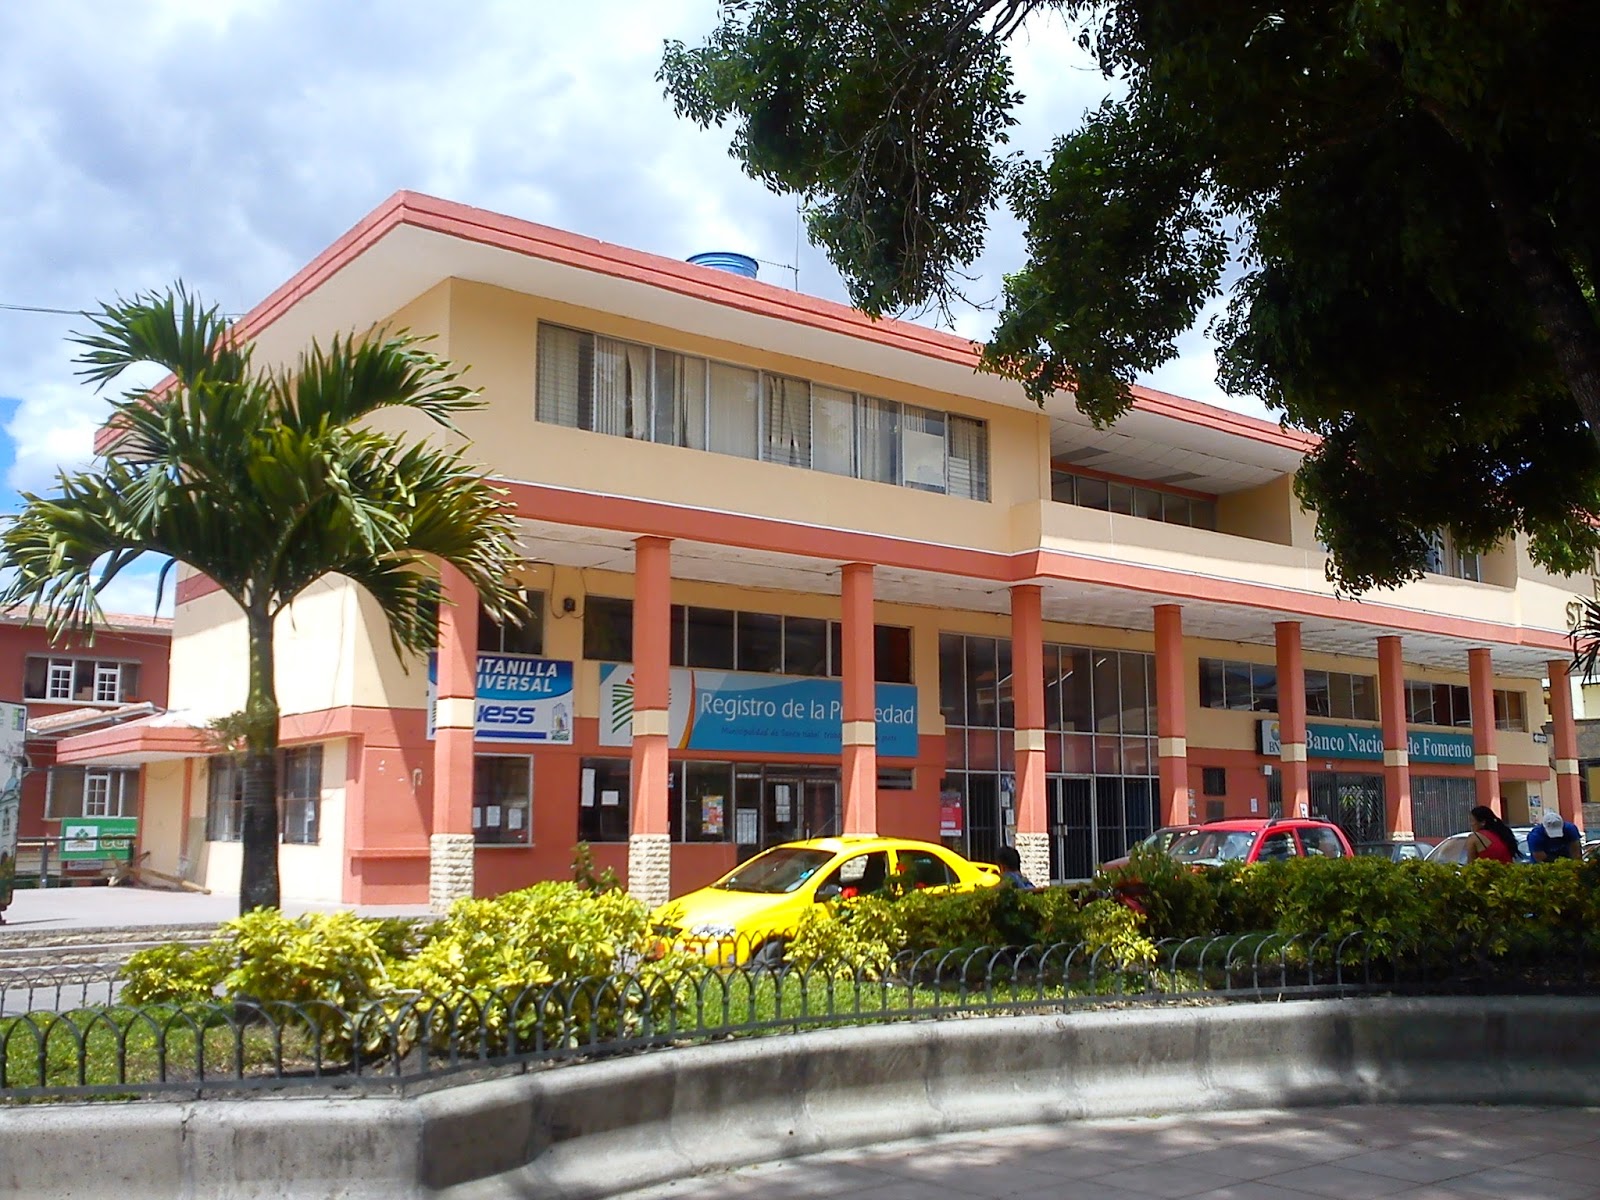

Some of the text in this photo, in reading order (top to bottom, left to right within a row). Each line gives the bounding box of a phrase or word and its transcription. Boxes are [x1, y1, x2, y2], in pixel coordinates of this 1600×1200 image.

[476, 658, 558, 678] NTANILLA
[477, 674, 553, 693] IVERSAL
[701, 692, 914, 724] Registro de la Pedad
[1269, 740, 1281, 753] BN
[1304, 729, 1472, 758] Banco Nacio de Fomento
